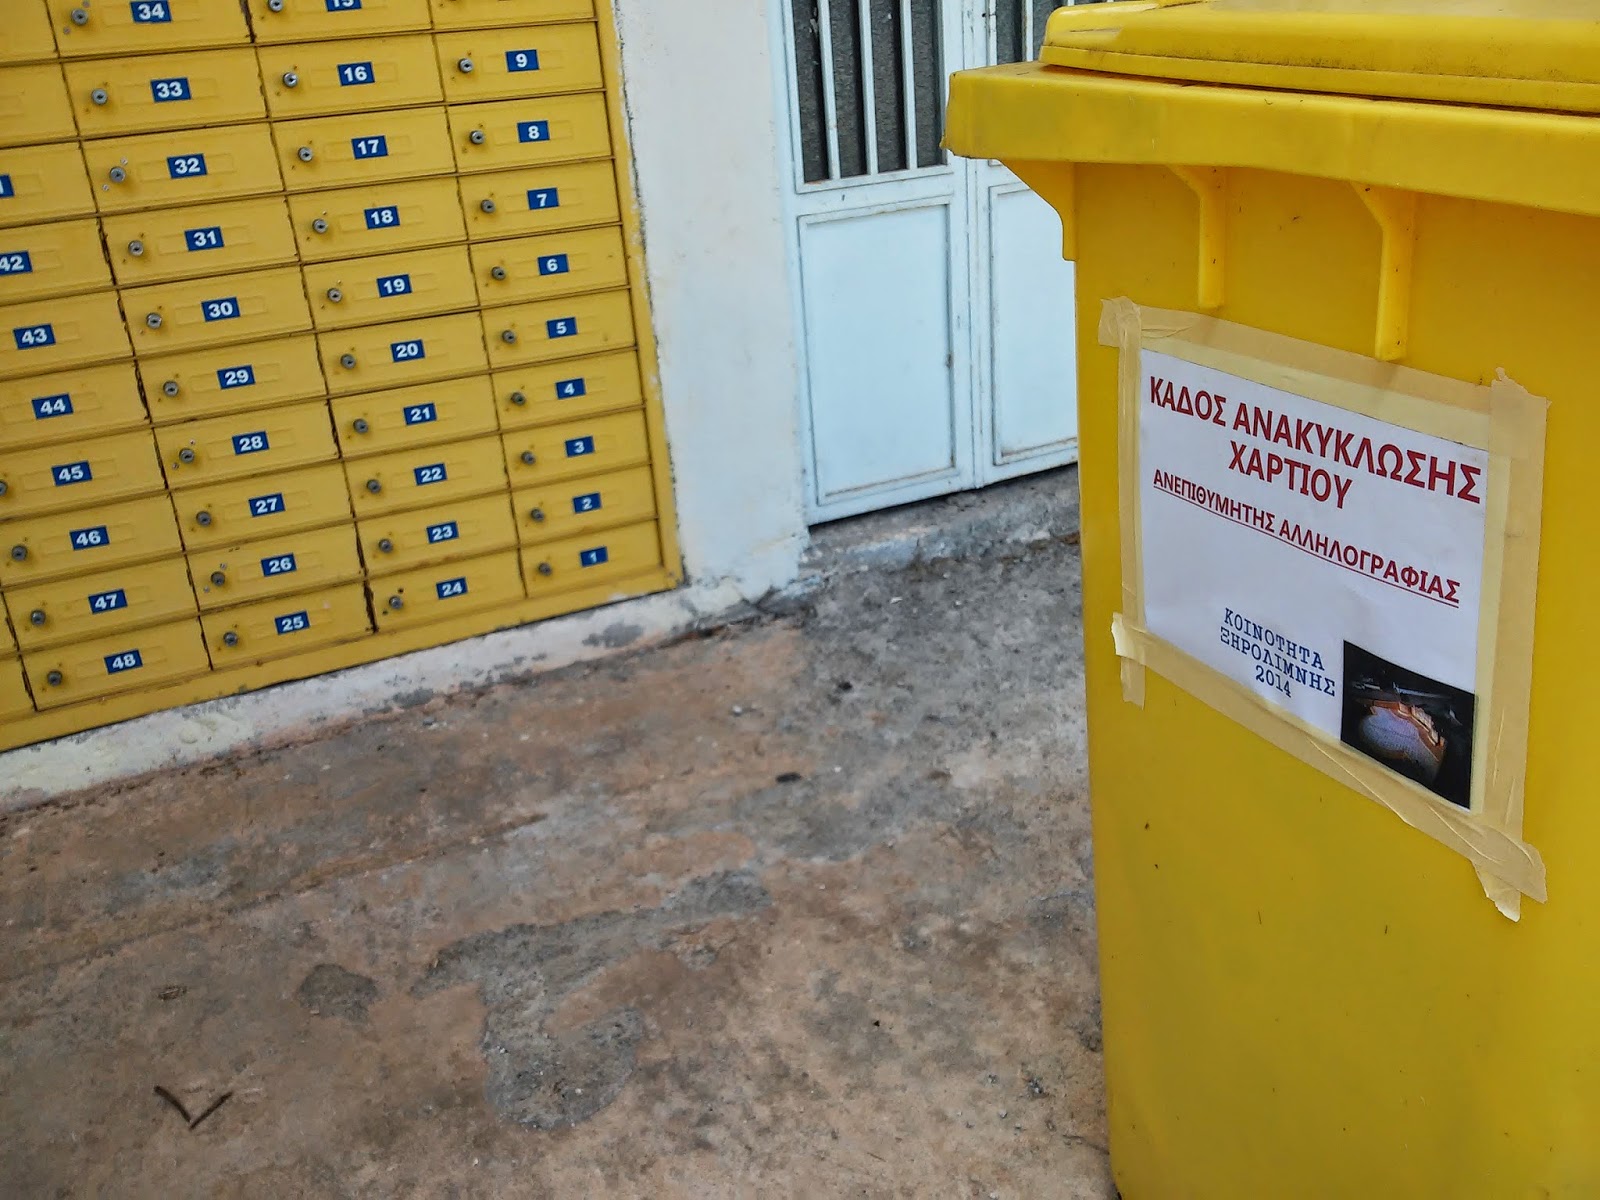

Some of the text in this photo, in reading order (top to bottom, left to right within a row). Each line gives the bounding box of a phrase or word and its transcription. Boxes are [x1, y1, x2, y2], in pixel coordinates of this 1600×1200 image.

[138, 3, 165, 19] 34
[515, 53, 528, 68] 9
[344, 66, 368, 82] 16
[156, 81, 183, 98] 33
[528, 125, 540, 140] 8
[357, 139, 379, 155] 17
[174, 157, 201, 174] 32
[536, 193, 547, 207] 7
[371, 209, 394, 225] 18
[193, 230, 217, 247] 31
[0, 255, 24, 272] 42
[546, 258, 558, 272] 6
[383, 278, 405, 294] 19
[208, 301, 233, 318] 30
[556, 321, 567, 334] 5
[21, 328, 48, 344] 43
[396, 343, 419, 358] 20
[224, 369, 249, 385] 29
[564, 383, 574, 395] 4
[40, 398, 66, 414] 44
[410, 407, 430, 421] 21
[239, 435, 263, 451] 28
[574, 441, 585, 454] 3
[1150, 376, 1482, 504] ΚΑΔΟΣ ΑΝΑΚΥΚΛΩΣΗΣ
[58, 465, 84, 481] 45
[421, 467, 442, 483] 22
[1228, 440, 1353, 510] ΧΑΡΤΙΟΥ
[255, 497, 277, 514] 27
[582, 497, 592, 510] 2
[76, 531, 101, 546] 46
[432, 526, 453, 541] 23
[1153, 468, 1461, 604] ΑΝΕΠΙΘΥΜΗΤΗΣ ΑΛΛΗΛΟΓΡΑΦΙΑΣ
[269, 558, 292, 573] 26
[590, 552, 597, 563] 1
[442, 582, 462, 596] 24
[95, 594, 117, 609] 47
[281, 616, 304, 631] 25
[1224, 607, 1325, 671] ΚΟΙΝΟΤΗΤΑ
[112, 654, 136, 669] 48
[1220, 626, 1336, 697] ΞΗΡΟΛΙΜΝΗΣ
[1255, 665, 1292, 699] 2014
